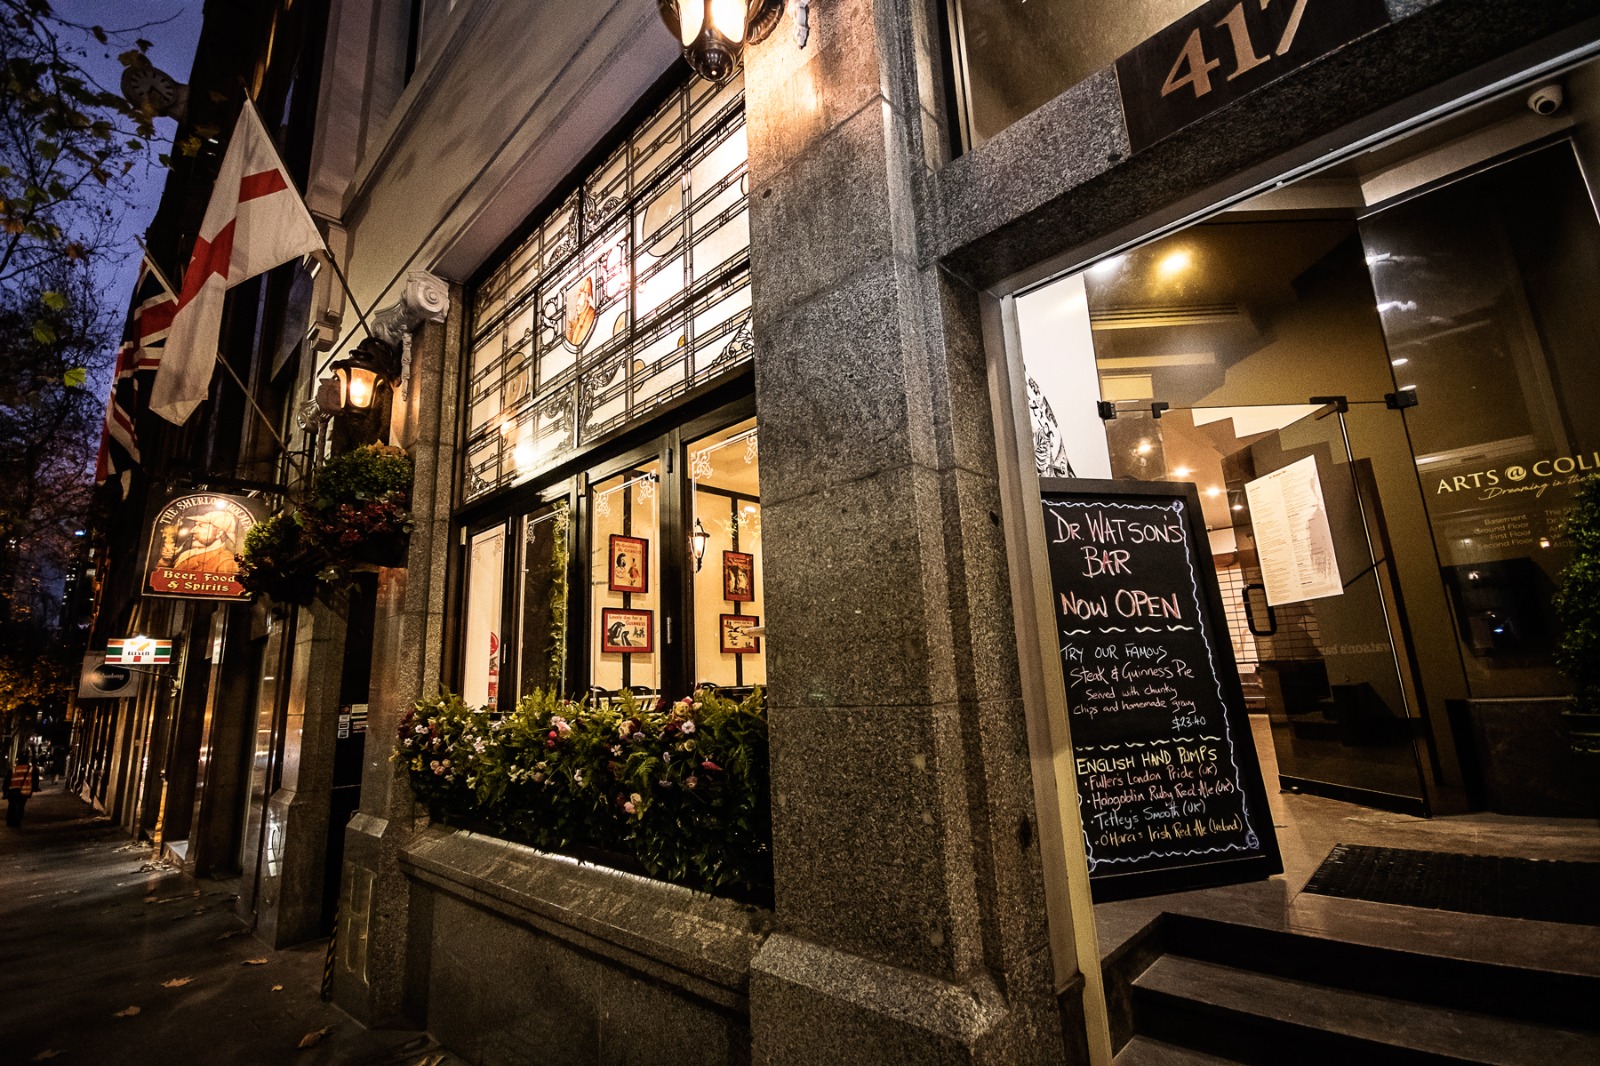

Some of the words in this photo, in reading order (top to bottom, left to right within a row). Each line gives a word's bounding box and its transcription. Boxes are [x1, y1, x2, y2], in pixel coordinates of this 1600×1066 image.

[1161, 0, 1308, 98] 417
[1436, 469, 1499, 494] ARTS
[1504, 465, 1527, 482] @
[1478, 482, 1549, 500] Dreaming
[1552, 478, 1566, 487] in
[160, 507, 179, 525] THE
[1484, 514, 1528, 526] Basement
[1474, 524, 1506, 535] Ground
[1507, 522, 1529, 532] Floor
[1490, 532, 1508, 540] First
[1509, 530, 1531, 539] Floor
[1511, 538, 1534, 546] Floor
[1081, 546, 1132, 578] BAR
[167, 580, 180, 590] &
[184, 582, 229, 592] Spirits
[204, 573, 236, 583] Food
[1060, 591, 1108, 620] NOW
[1115, 589, 1182, 620] OPEN
[1060, 643, 1084, 663] TRY
[1095, 645, 1119, 660] OUR
[1124, 643, 1168, 664] FAMOUS
[1070, 666, 1109, 688] Steak
[1111, 666, 1119, 682] &
[1122, 662, 1174, 682] Guinness
[1172, 659, 1194, 678] Pie
[1086, 686, 1116, 700] Served
[1122, 686, 1140, 696] with
[1102, 702, 1119, 712] and
[1122, 698, 1167, 711] homemade
[1172, 700, 1196, 715] gravy
[1172, 716, 1206, 731] $23.40
[1076, 756, 1136, 774] ENGLISH
[1142, 748, 1172, 767] HAND
[1177, 745, 1218, 764] PUMPS
[1127, 770, 1162, 785] London
[1166, 764, 1194, 780] Pride
[1198, 762, 1218, 776] (UK)
[1092, 790, 1145, 811] Hobgoblin
[1149, 785, 1174, 803] Ruby
[1174, 782, 1196, 798] Red
[1196, 780, 1214, 798] Ale
[1215, 778, 1235, 796] (UK)
[1143, 801, 1180, 820] Smooth
[1182, 798, 1206, 816] (UK)
[1148, 824, 1172, 842] Irish
[1172, 822, 1192, 838] Red
[1194, 819, 1208, 836] Ale
[1208, 814, 1242, 834] (Ireland)
